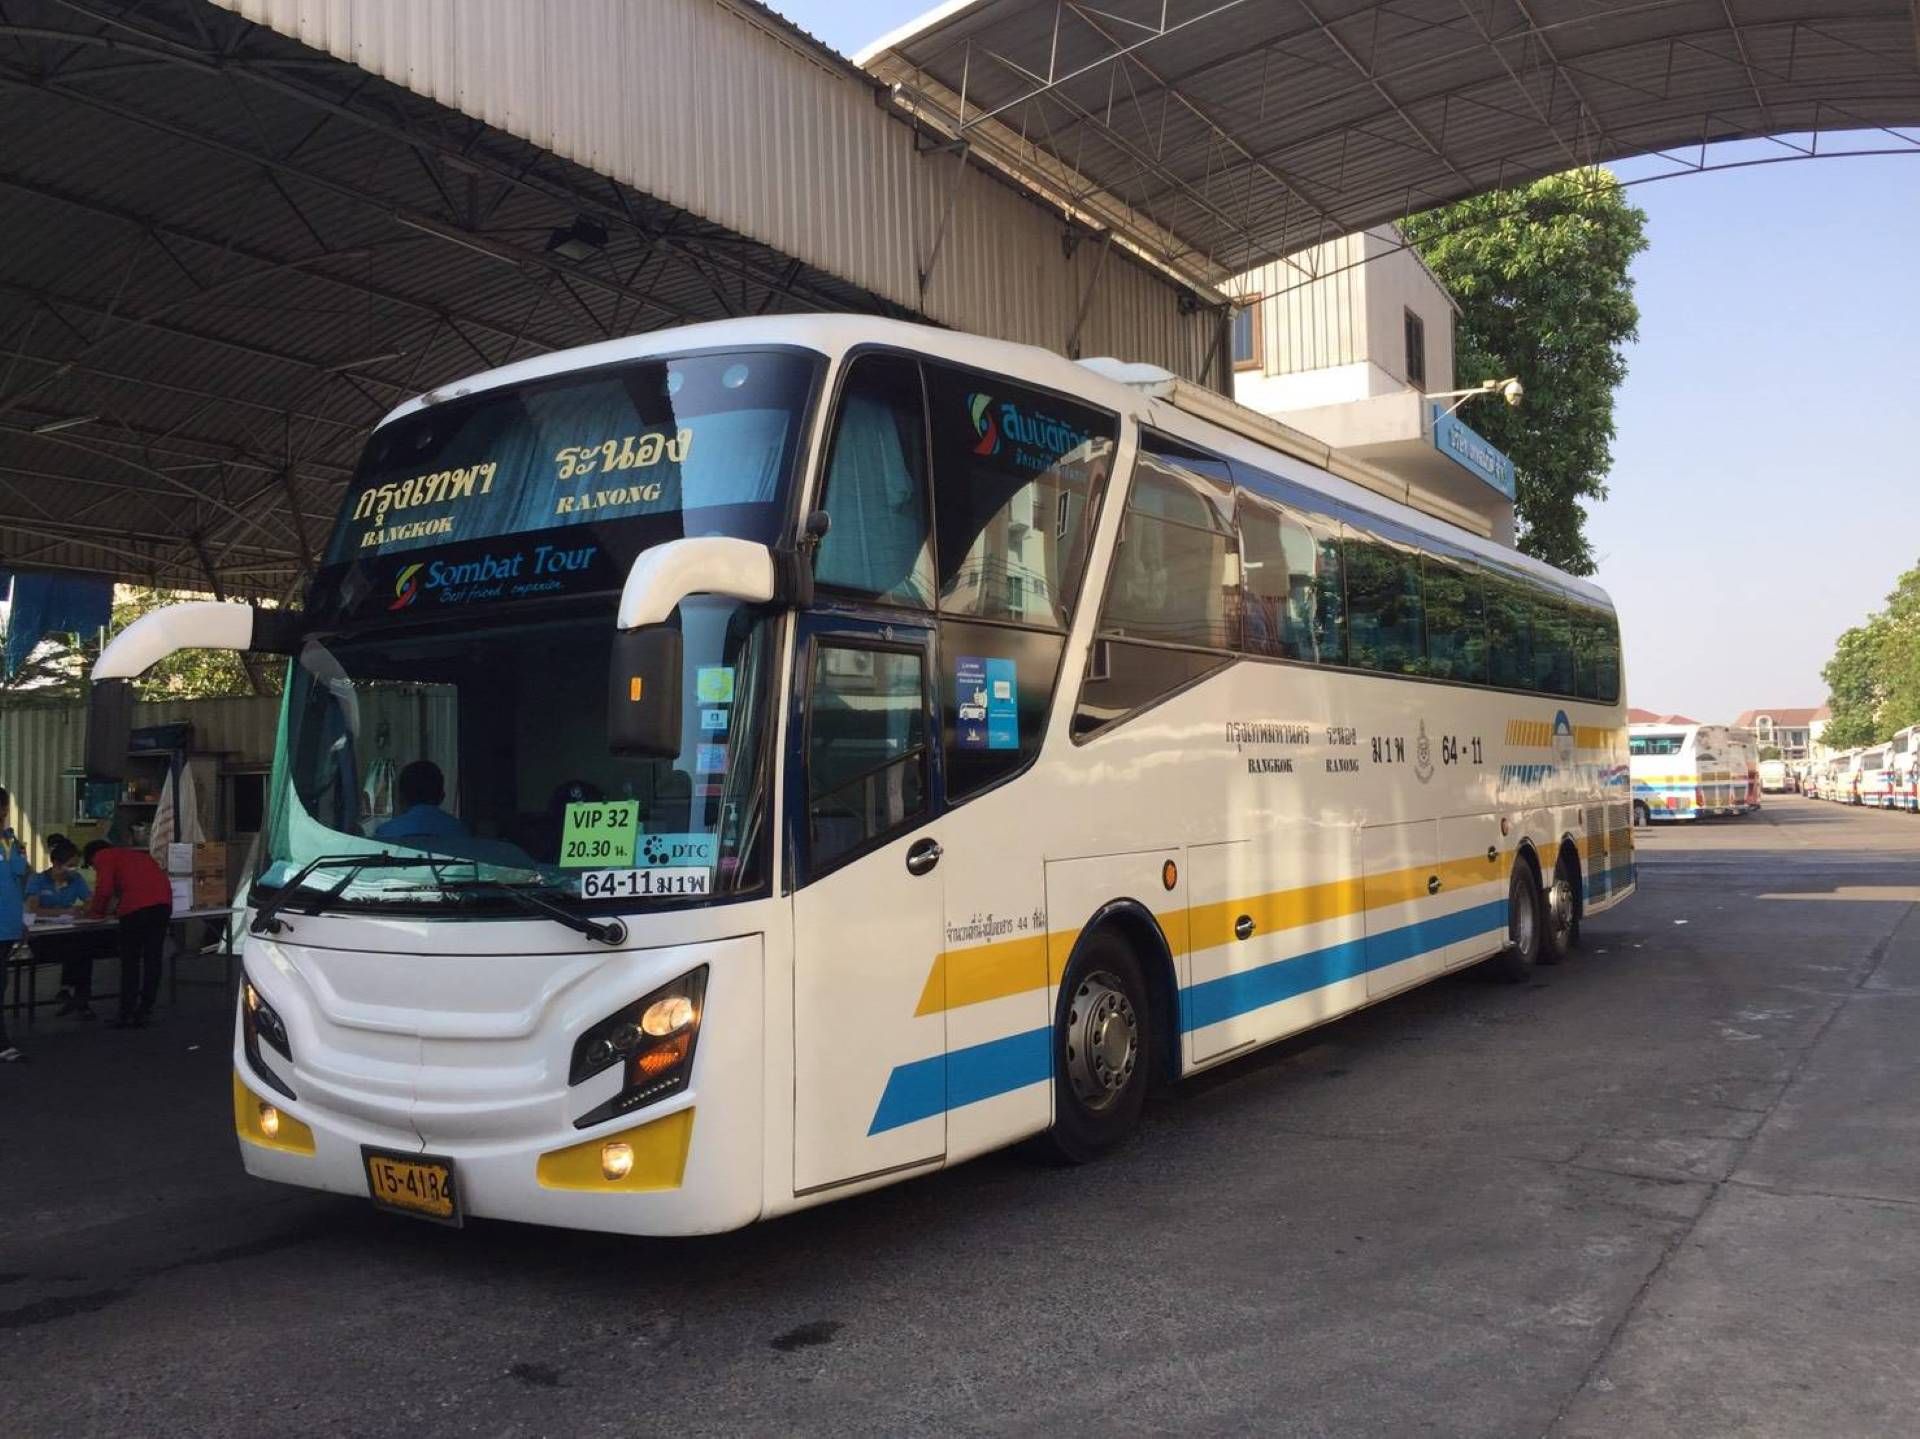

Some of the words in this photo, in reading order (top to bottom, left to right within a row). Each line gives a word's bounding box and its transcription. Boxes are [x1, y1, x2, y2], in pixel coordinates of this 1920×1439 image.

[555, 428, 693, 480] ระนอง
[352, 462, 497, 527] กรุงเทพฯ
[555, 482, 663, 514] RANONG
[360, 516, 455, 548] BANGKOK
[425, 553, 524, 589] Sombat
[534, 546, 598, 574] Tour
[1248, 758, 1293, 773] BANGKOK
[1326, 758, 1359, 773] RANONG
[573, 809, 602, 828] VIP
[606, 809, 629, 827] 32
[567, 840, 611, 858] 20.30
[672, 844, 709, 858] DTC
[584, 871, 654, 897] 64-11
